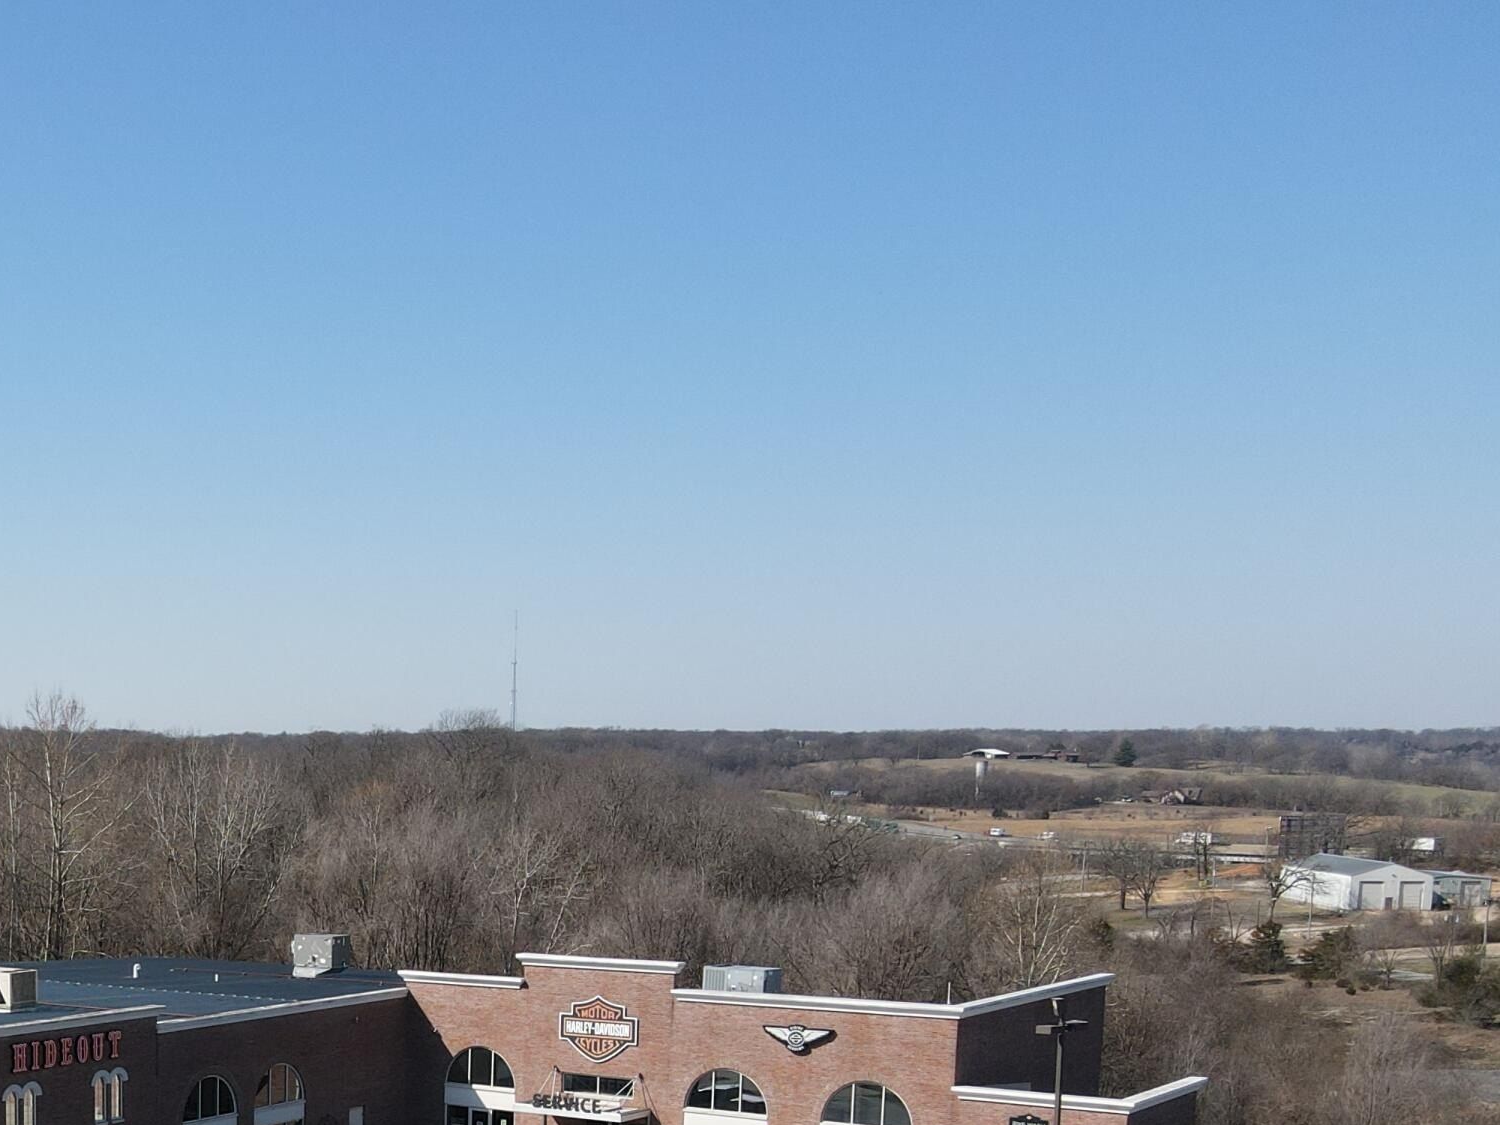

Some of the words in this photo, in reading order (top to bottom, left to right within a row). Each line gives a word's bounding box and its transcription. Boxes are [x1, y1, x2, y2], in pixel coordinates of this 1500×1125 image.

[581, 1004, 615, 1020] MOTOR
[566, 1020, 630, 1038] HARLEY-DAVIDSON
[12, 1030, 122, 1073] HIDEOUT
[580, 1037, 615, 1054] CYCLES
[532, 1093, 602, 1114] SERVICE
